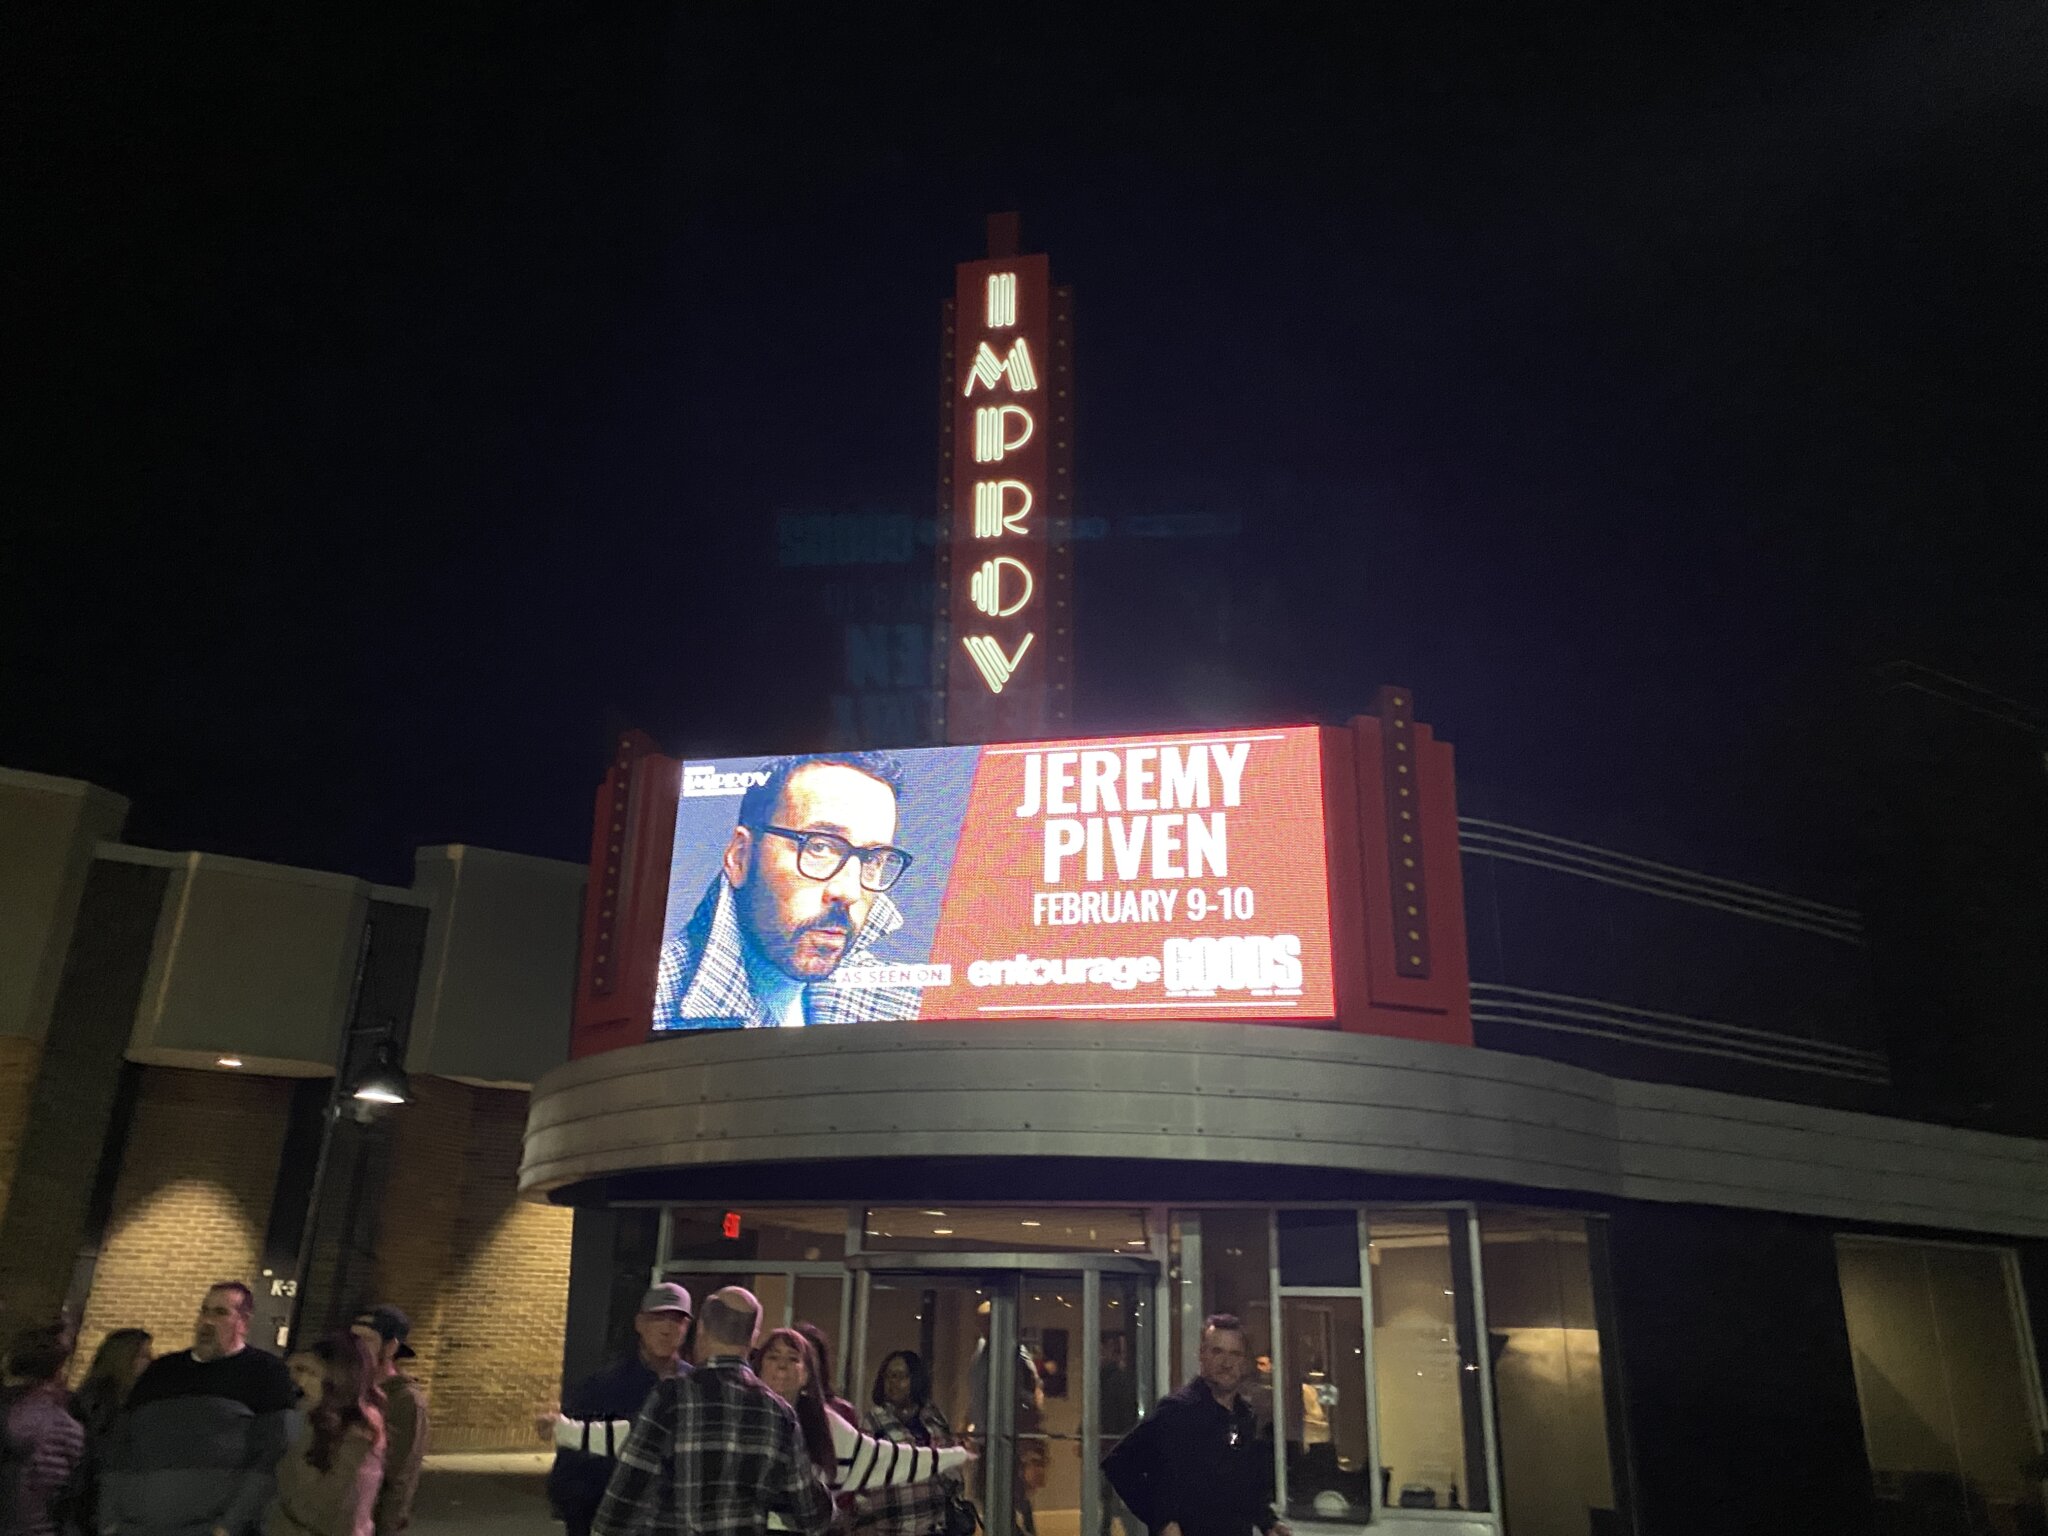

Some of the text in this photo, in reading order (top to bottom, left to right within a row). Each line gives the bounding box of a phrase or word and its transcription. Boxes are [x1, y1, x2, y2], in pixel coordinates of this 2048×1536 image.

[964, 272, 1038, 695] IMPROV
[684, 772, 771, 789] IMPROV
[1016, 743, 1251, 817] JEREMY
[1043, 812, 1229, 884] PIVEN
[1033, 886, 1254, 926] FEBRUARY 9-10
[841, 969, 943, 984] AS SEEN ON
[967, 953, 1161, 990] entourage
[1164, 935, 1303, 991] GOODS
